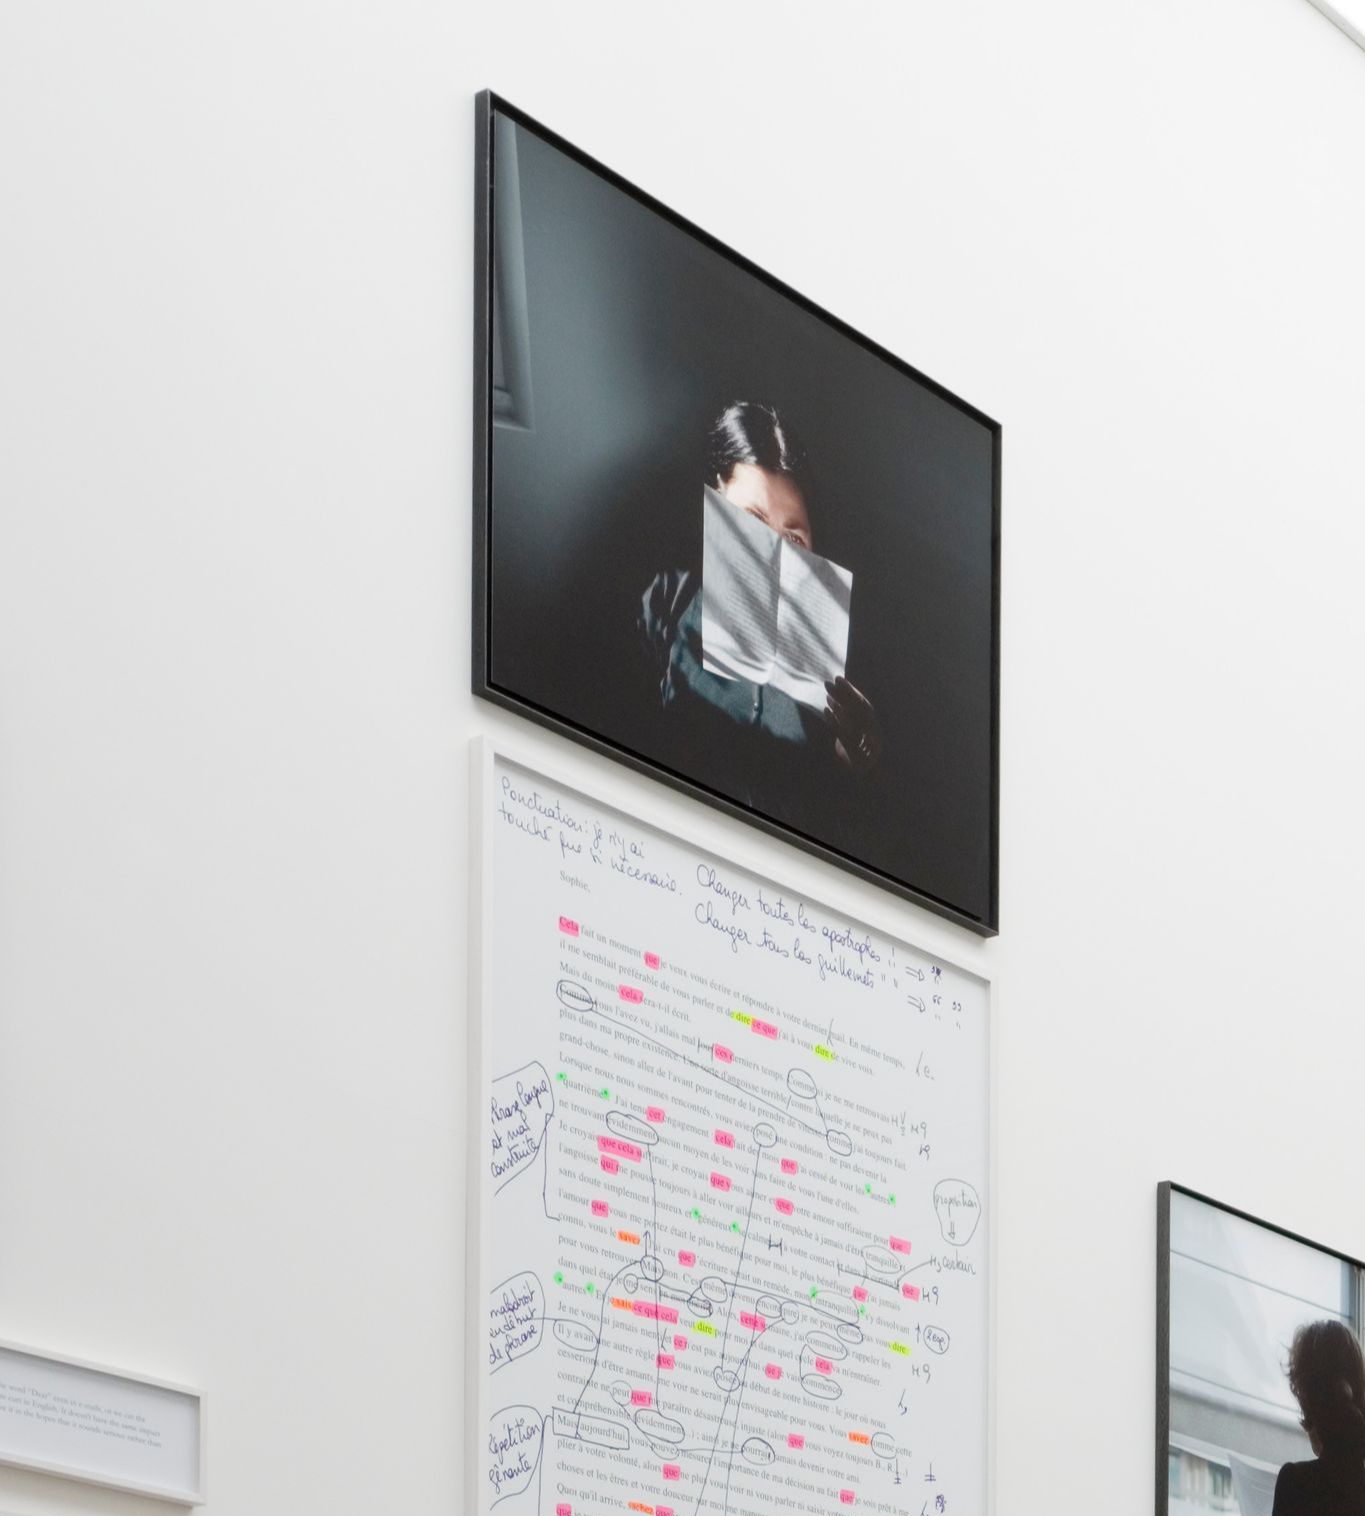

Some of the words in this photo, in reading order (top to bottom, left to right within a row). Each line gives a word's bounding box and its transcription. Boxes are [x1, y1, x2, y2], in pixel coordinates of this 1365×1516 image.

[697, 864, 750, 914] Changer
[758, 890, 794, 926] toutes
[798, 903, 817, 933] les
[560, 961, 580, 977] Mais
[582, 971, 593, 982] du
[621, 988, 637, 1000] cela
[560, 940, 566, 949] il
[568, 944, 580, 955] me
[582, 948, 616, 970] semblait
[619, 961, 658, 988] préférable
[660, 980, 670, 992] de
[672, 986, 690, 999] vous
[692, 994, 714, 1012] parler
[716, 1003, 724, 1014] et
[736, 1010, 750, 1025] dire
[560, 916, 579, 932] Cela
[581, 925, 594, 939] fait
[596, 934, 607, 944] un
[609, 939, 641, 957] moment
[690, 972, 708, 985] vous
[710, 978, 731, 996] écrire
[733, 989, 740, 998] et
[742, 994, 774, 1015] répondre
[783, 1011, 800, 1025] votre
[802, 1018, 828, 1035] dernier
[861, 1043, 882, 1058] même
[695, 903, 751, 953] Changer
[757, 928, 790, 958] tous
[794, 939, 811, 964] les
[818, 952, 874, 988] guillemets
